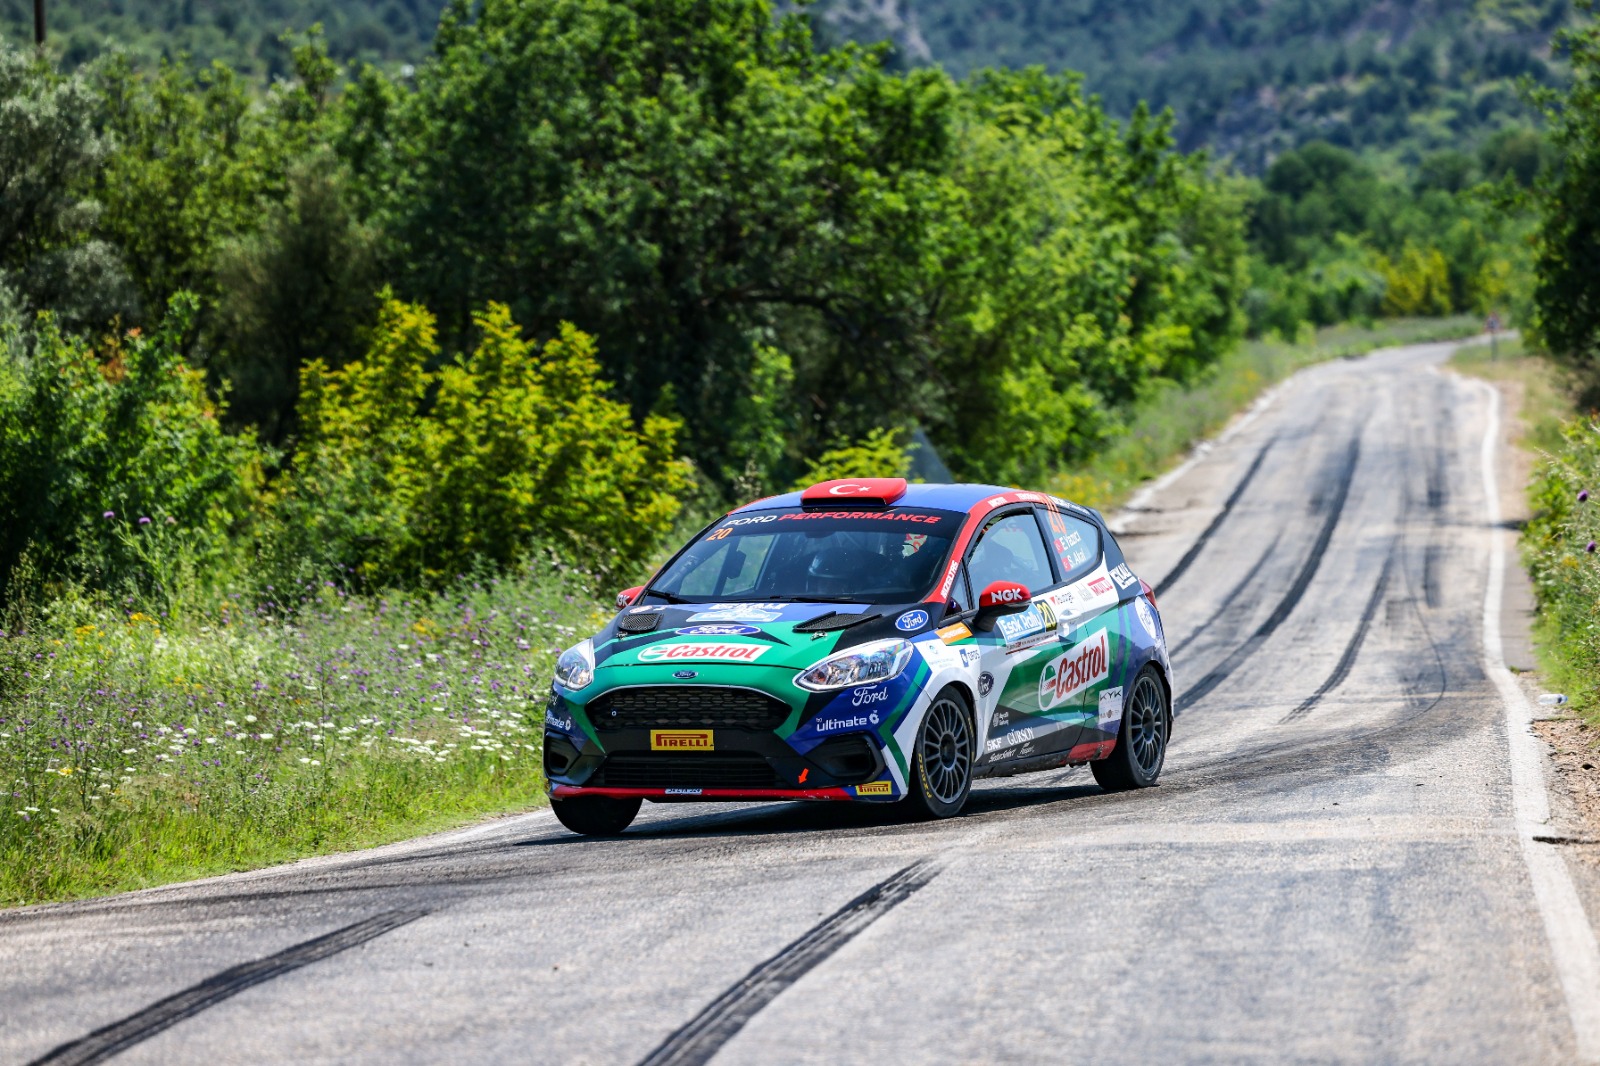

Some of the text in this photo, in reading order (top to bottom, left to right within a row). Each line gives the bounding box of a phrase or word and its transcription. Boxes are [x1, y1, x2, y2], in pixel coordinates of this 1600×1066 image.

[723, 511, 942, 527] FORD PERFORMANCE
[706, 528, 733, 541] 20
[616, 594, 630, 606] GK
[991, 588, 1023, 603] NGK
[902, 613, 924, 628] Ford
[1022, 611, 1043, 631] Rally
[1037, 602, 1057, 627] 20
[689, 624, 746, 634] Ford
[666, 645, 760, 659] Castrol
[1056, 635, 1107, 699] Castrol
[852, 684, 888, 706] Ford
[1100, 690, 1121, 701] KYK
[816, 716, 867, 732] ultimate
[656, 734, 708, 746] PIRELLI
[987, 737, 1002, 751] SKF
[859, 784, 888, 793] PIRELLI
